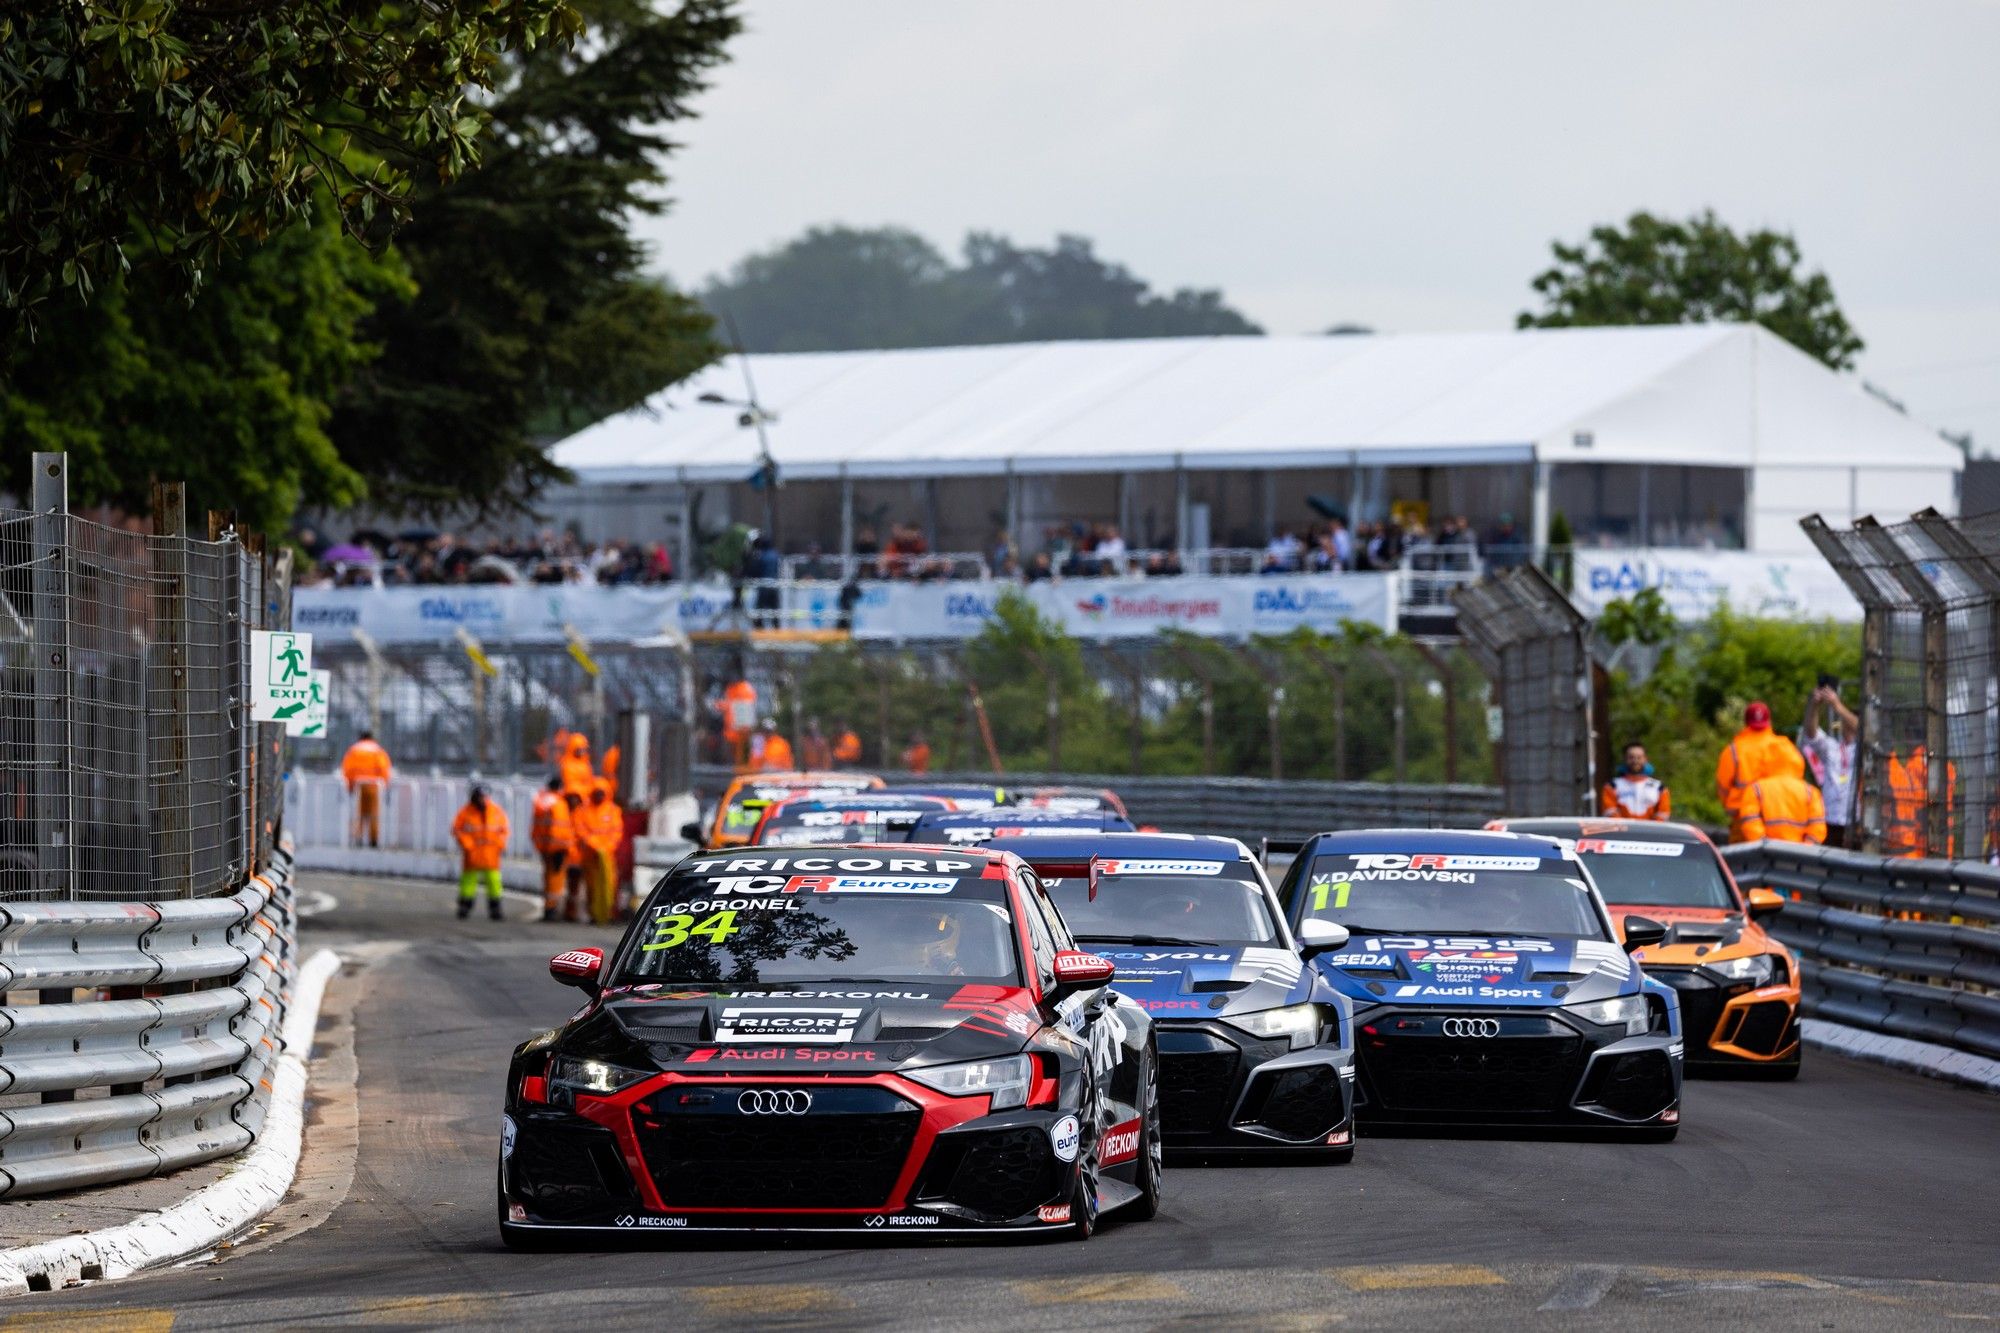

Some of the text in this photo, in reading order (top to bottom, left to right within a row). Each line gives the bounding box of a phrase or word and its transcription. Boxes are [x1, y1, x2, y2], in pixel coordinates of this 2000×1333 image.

[270, 689, 307, 699] EXIT
[692, 858, 972, 873] TRICORP
[1123, 863, 1219, 872] Europe
[1348, 854, 1536, 870] TCR Europe
[1312, 869, 1476, 885] V.DAVIDOVSKI
[707, 875, 951, 895] TCR Europe
[1310, 882, 1352, 911] 11
[653, 898, 800, 918] T.CORONEL
[642, 911, 740, 951] 34
[1331, 954, 1393, 966] SEDA
[729, 991, 930, 1000] IRECKONU
[1421, 985, 1543, 998] Audi Sport
[1135, 999, 1200, 1010] Sport
[720, 1018, 858, 1027] TRICORP
[719, 1048, 876, 1062] Audi Sport
[638, 1216, 688, 1227] IRECKONU
[888, 1215, 939, 1226] IRECKONU
